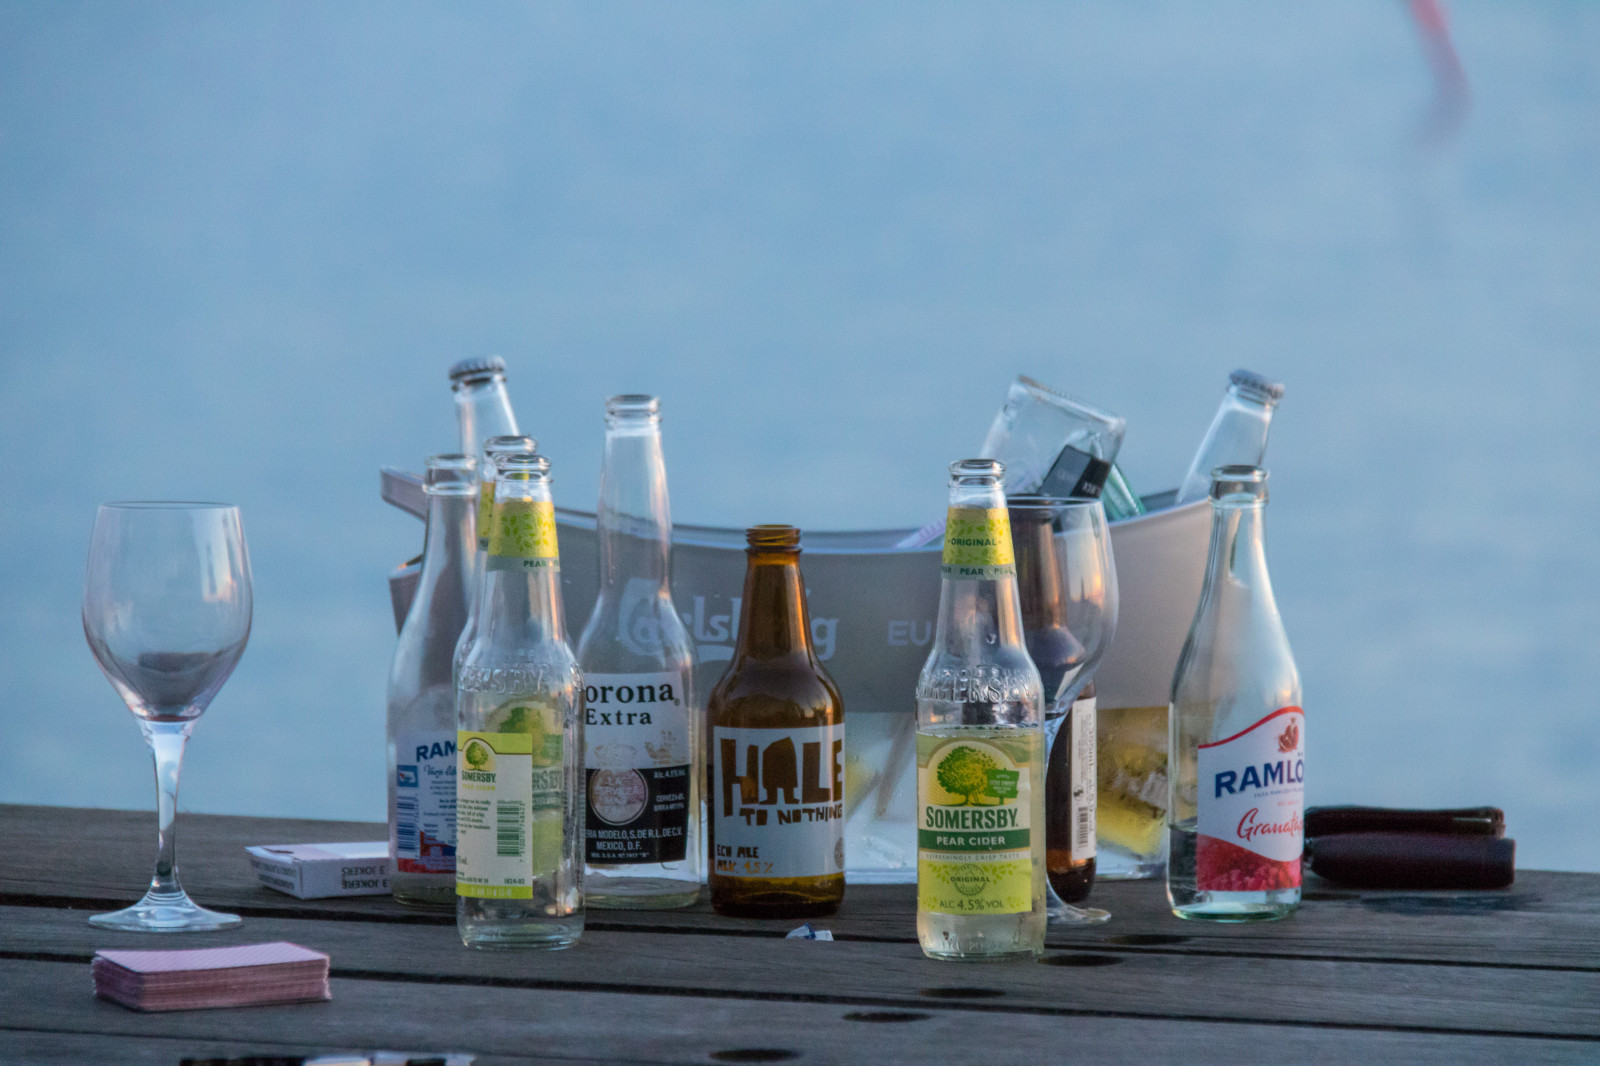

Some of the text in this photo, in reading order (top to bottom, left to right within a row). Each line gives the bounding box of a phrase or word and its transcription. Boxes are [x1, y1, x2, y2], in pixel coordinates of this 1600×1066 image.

[951, 537, 997, 547] ORIGINAL
[523, 560, 547, 568] PEAR
[959, 567, 984, 576] PEAR
[618, 577, 839, 662] Carlsg
[887, 620, 932, 647] EU
[585, 682, 675, 707] orona
[585, 708, 652, 727] Extra
[416, 741, 457, 763] RAM
[720, 736, 843, 818] HOLE
[1214, 751, 1305, 799] RAMLÖ
[739, 803, 843, 826] TO NOTHING
[936, 835, 1006, 847] PEAR CIDER
[975, 853, 997, 861] CRISP
[939, 900, 955, 909] ALC
[985, 900, 1004, 909] VOL
